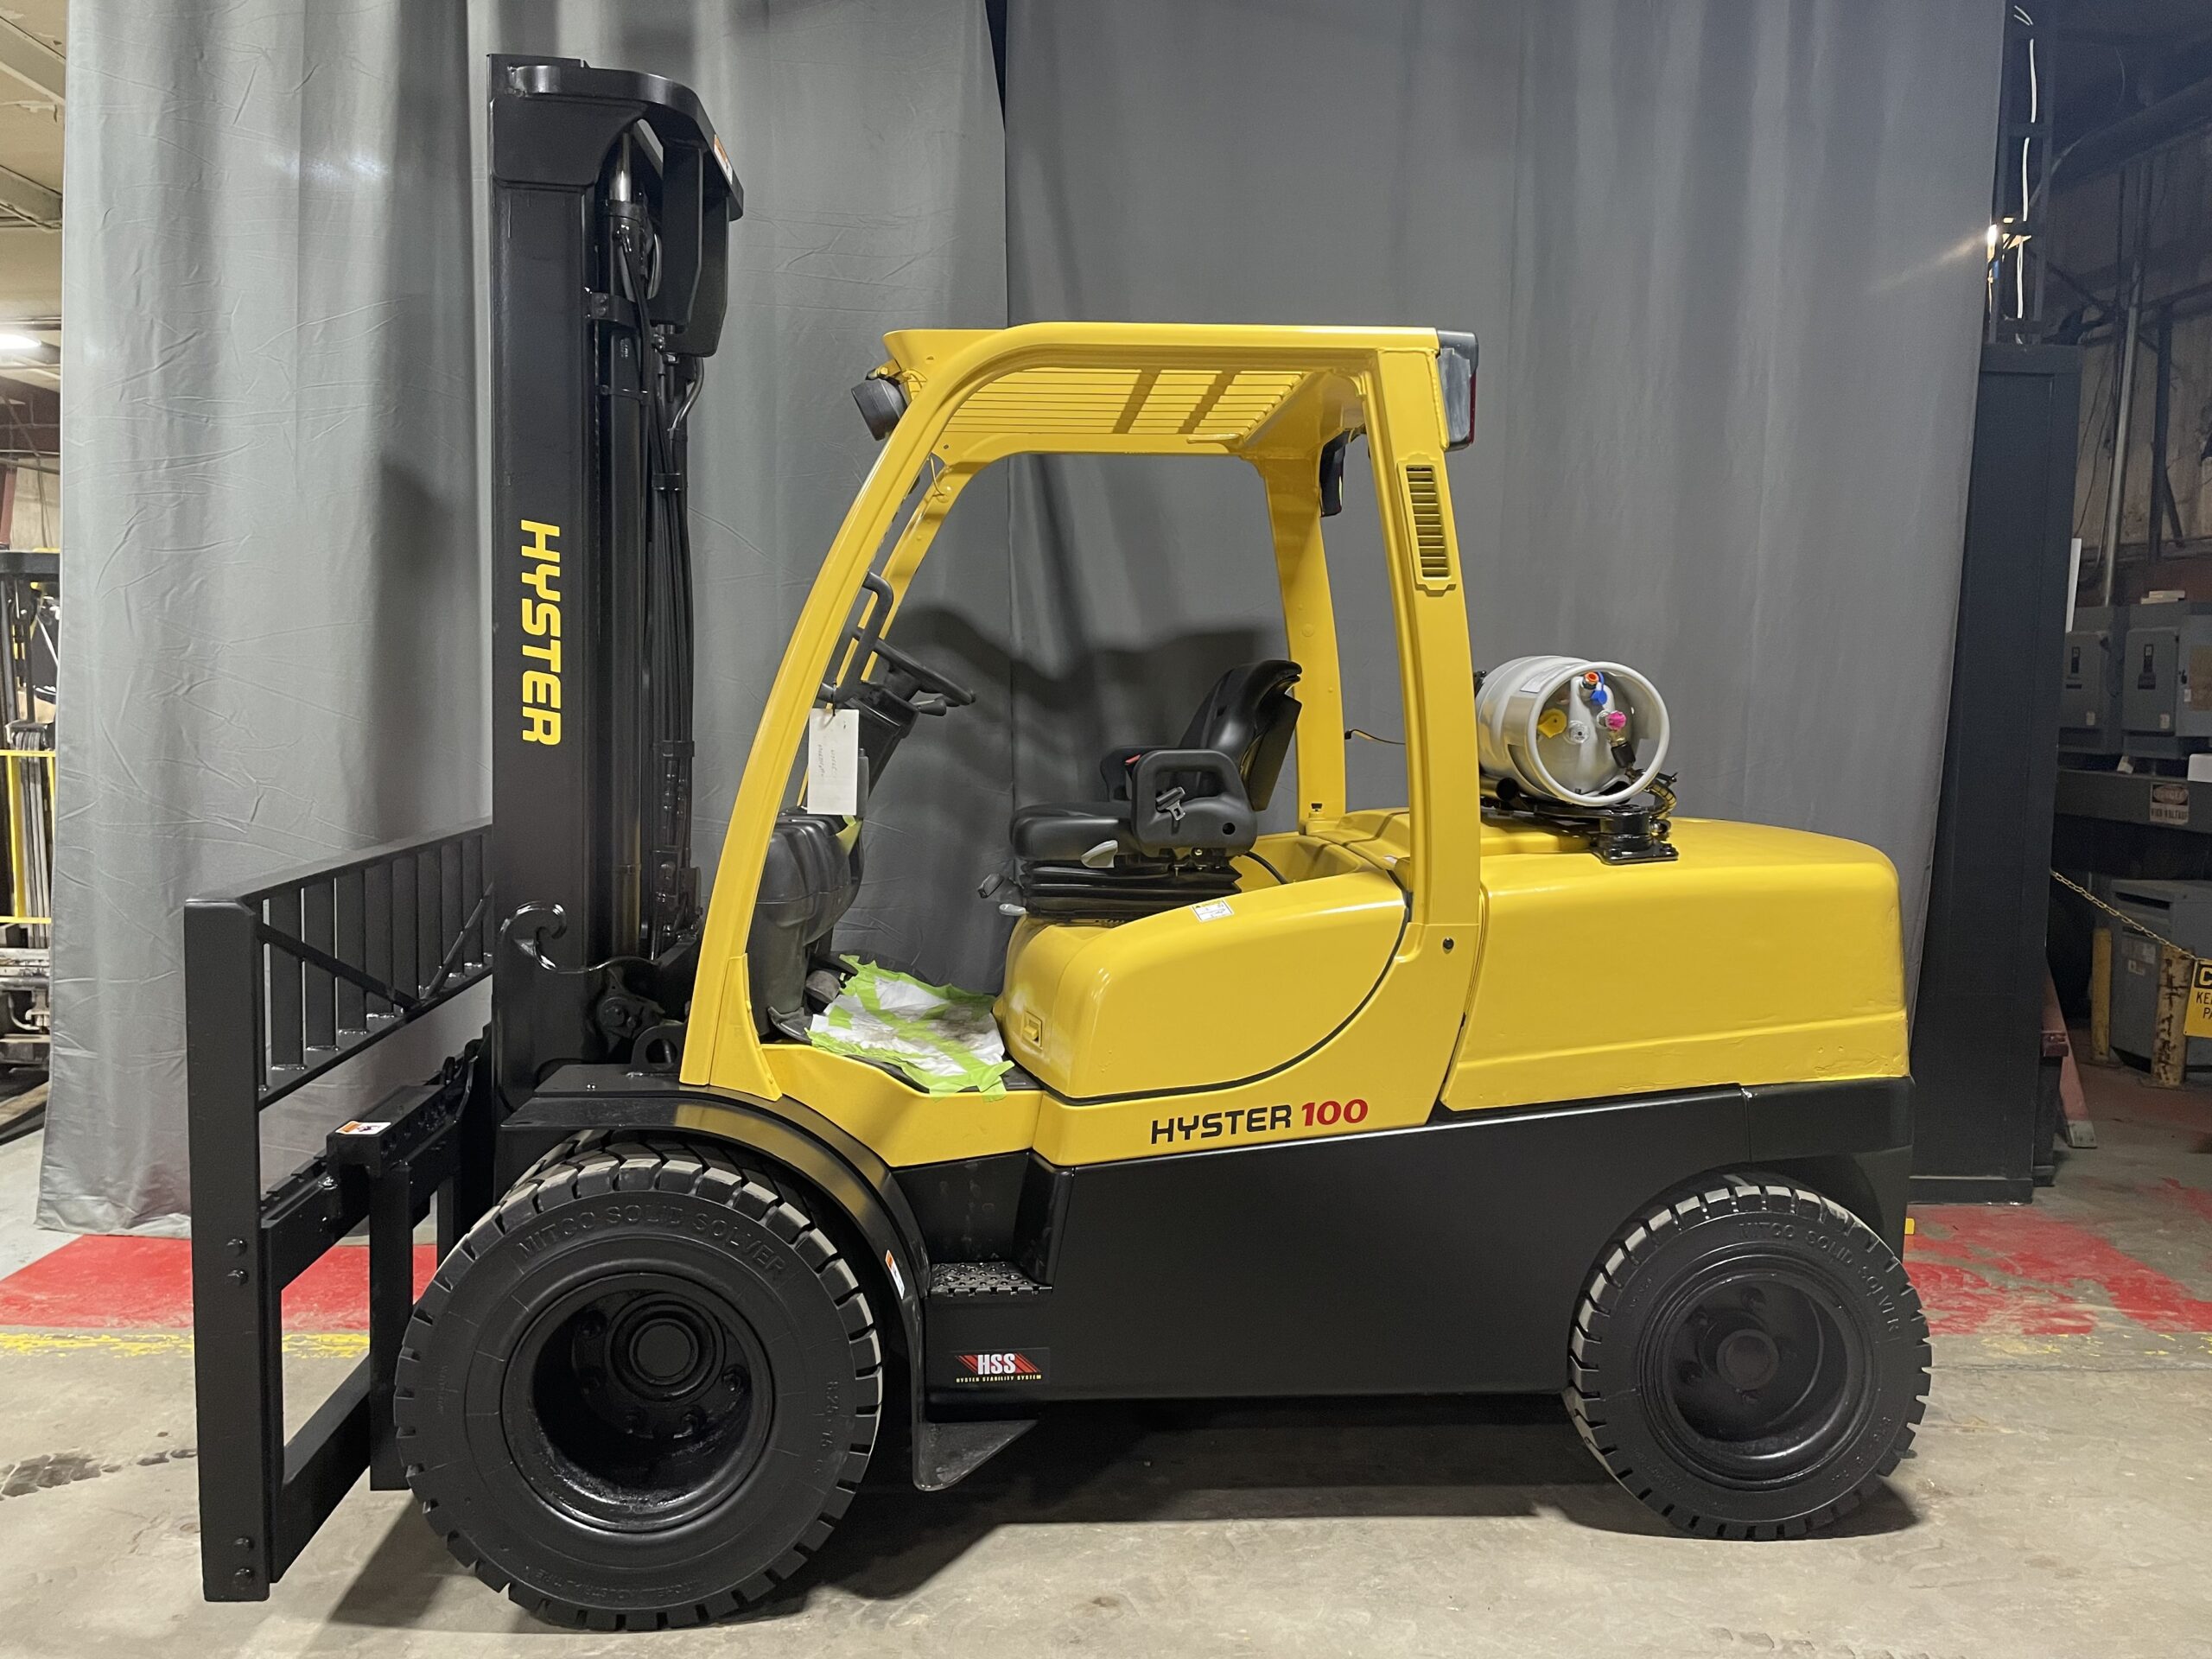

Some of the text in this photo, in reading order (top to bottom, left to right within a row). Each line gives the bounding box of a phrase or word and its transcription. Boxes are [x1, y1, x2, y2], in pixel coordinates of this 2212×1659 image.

[520, 519, 562, 746] HYSTER
[1151, 1098, 1369, 1145] HYSTER 100
[518, 1204, 786, 1274] MITCO SOLID SOLVER
[977, 1352, 1016, 1375] HSS
